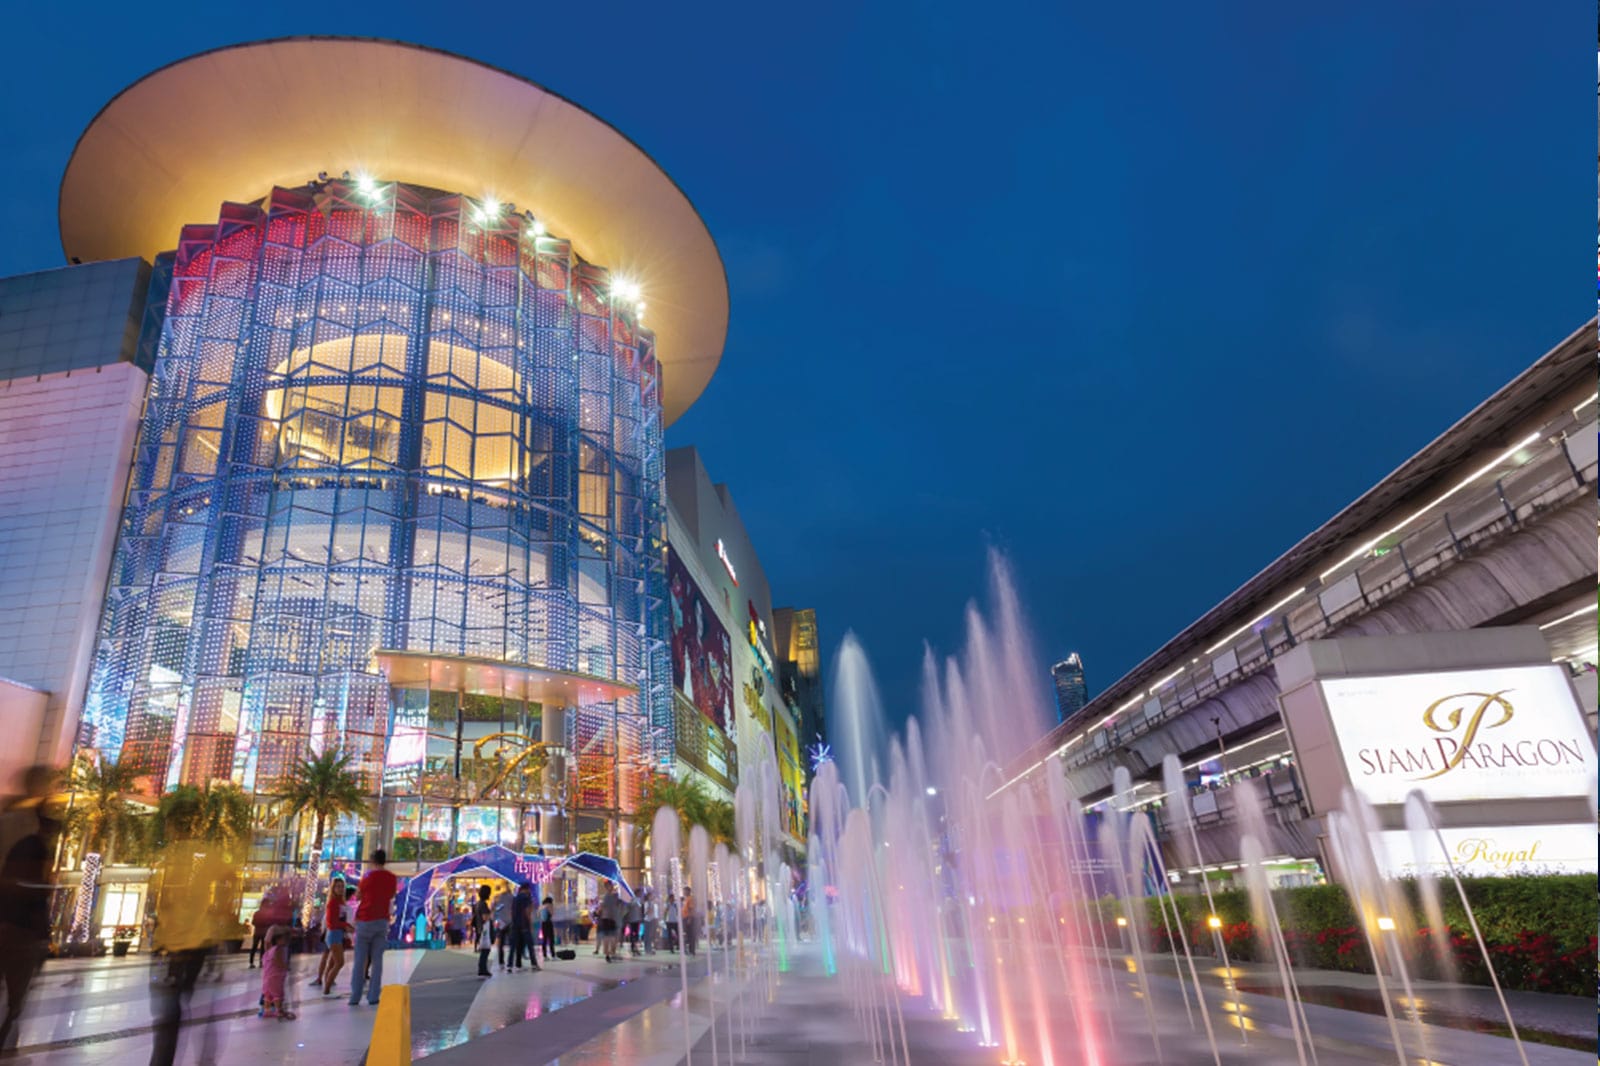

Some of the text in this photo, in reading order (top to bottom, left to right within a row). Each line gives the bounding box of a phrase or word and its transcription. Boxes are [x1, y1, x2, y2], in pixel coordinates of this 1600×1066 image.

[1358, 736, 1586, 775] SIAM PARAGON
[1453, 838, 1542, 869] Royal
